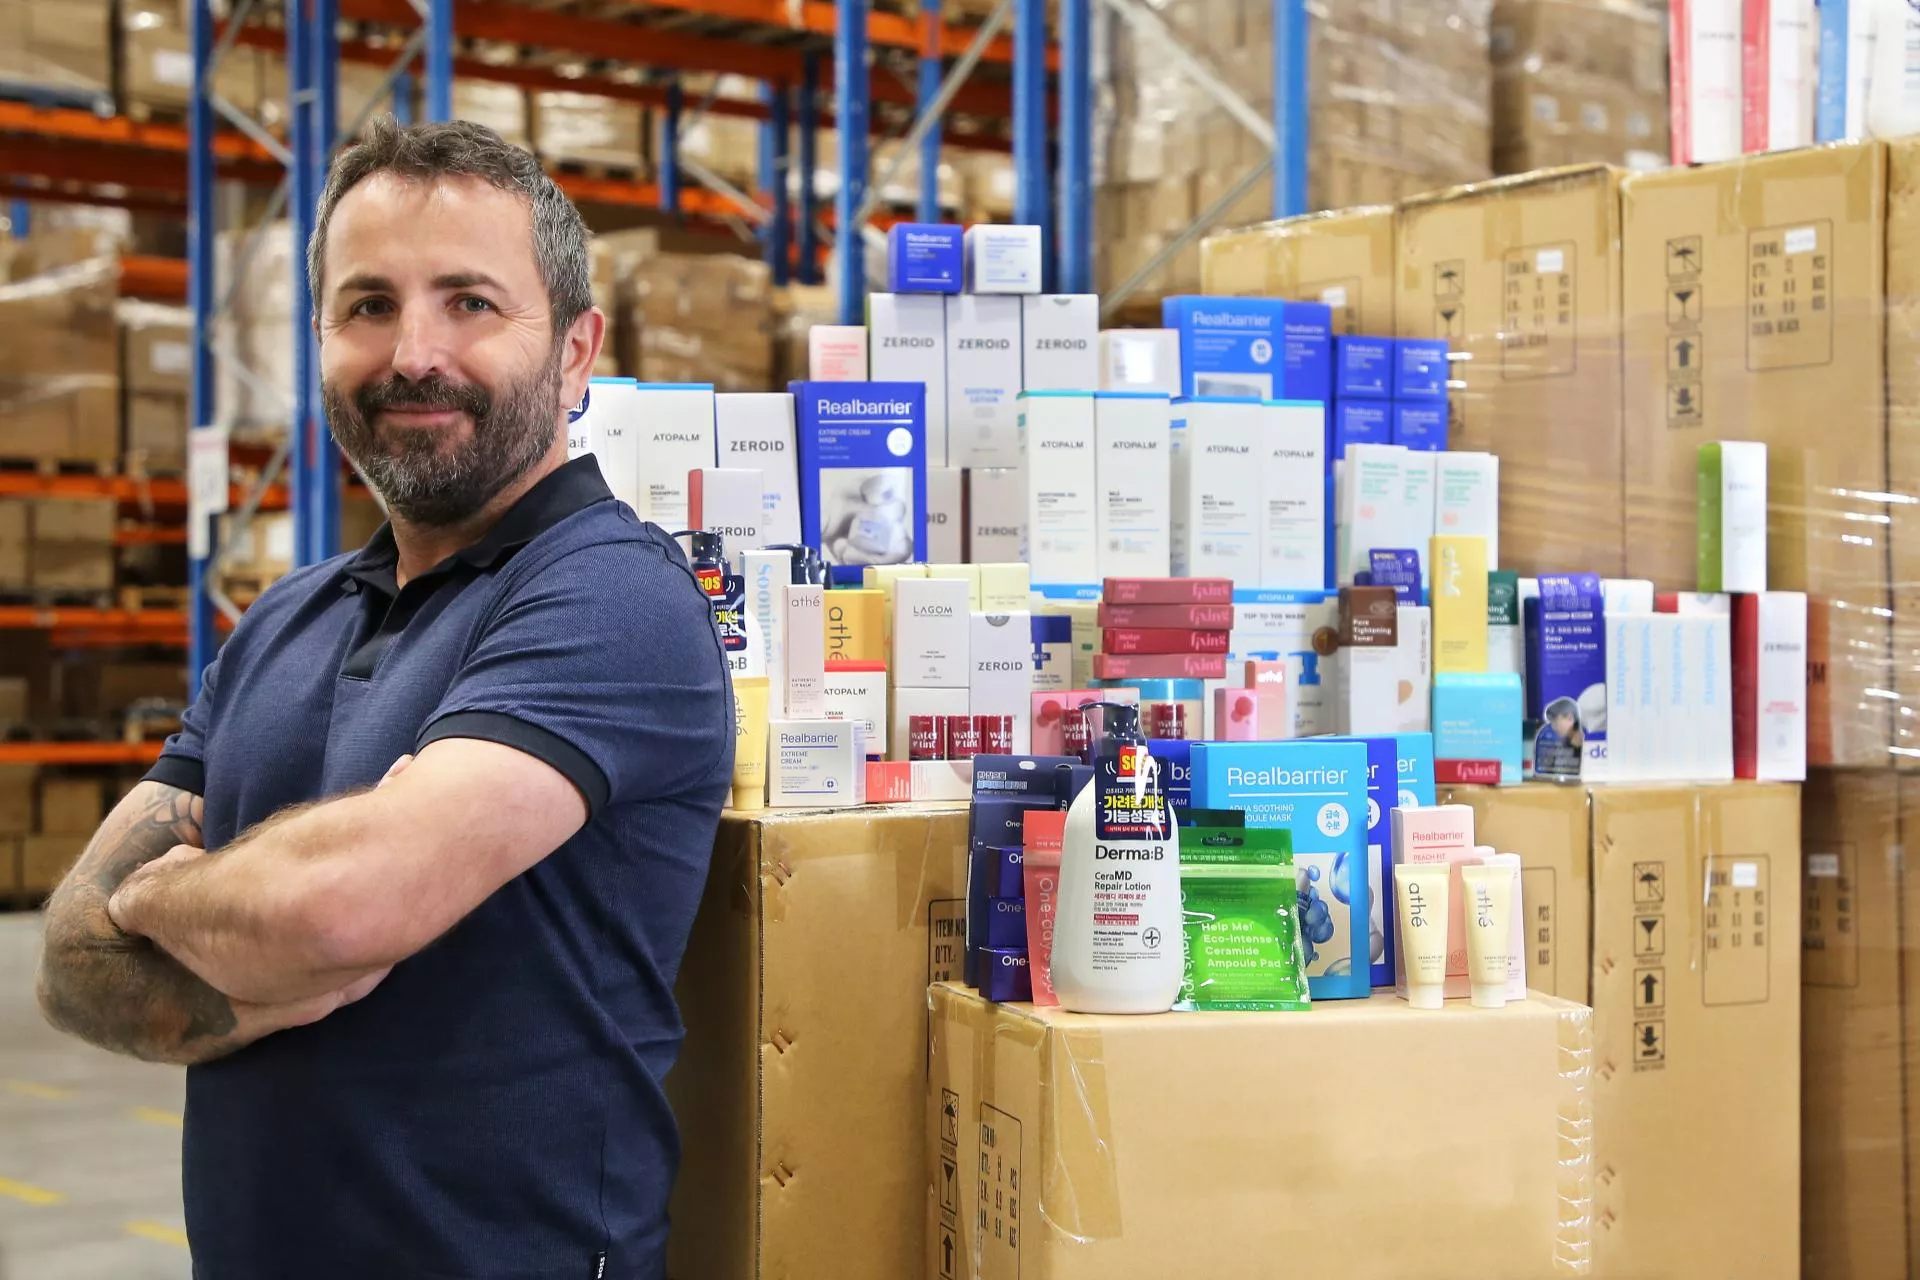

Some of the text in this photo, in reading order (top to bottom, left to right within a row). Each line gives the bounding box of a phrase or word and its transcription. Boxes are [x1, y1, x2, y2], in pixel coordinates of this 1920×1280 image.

[1193, 311, 1271, 327] Realbarrier
[883, 337, 935, 347] ZEROID
[958, 339, 1010, 349] ZEROID
[1036, 339, 1087, 349] ZEROID
[817, 398, 913, 415] Realbarrier
[653, 433, 700, 442] ATOPALM
[731, 441, 785, 451] ZEROID
[1041, 441, 1084, 449] ATOPALM
[1112, 441, 1157, 449] ATOPALM
[1207, 446, 1249, 454] ATOPALM
[1273, 450, 1314, 458] ATOPALM
[791, 595, 820, 607] athé
[913, 606, 953, 614] LAGOM
[978, 662, 1023, 671] ZEROID
[780, 733, 838, 743] Realbarrier
[989, 731, 1012, 739] wate
[1227, 766, 1348, 786] Realbarrier
[1253, 804, 1294, 812] SOOTHING
[1269, 812, 1292, 821] MASK
[1412, 831, 1464, 842] Realbarrier
[1096, 845, 1164, 861] Derma:B
[1094, 870, 1132, 881] CeraMD
[1094, 882, 1151, 891] Repair Lotion
[1408, 883, 1428, 928] athé
[1476, 884, 1494, 928] athé
[935, 918, 966, 938] ITEM NO
[1201, 923, 1229, 933] Help
[1203, 934, 1272, 943] Eco-Intense
[1205, 946, 1260, 955] Ceramide
[1207, 958, 1281, 969] Ampoule Pad
